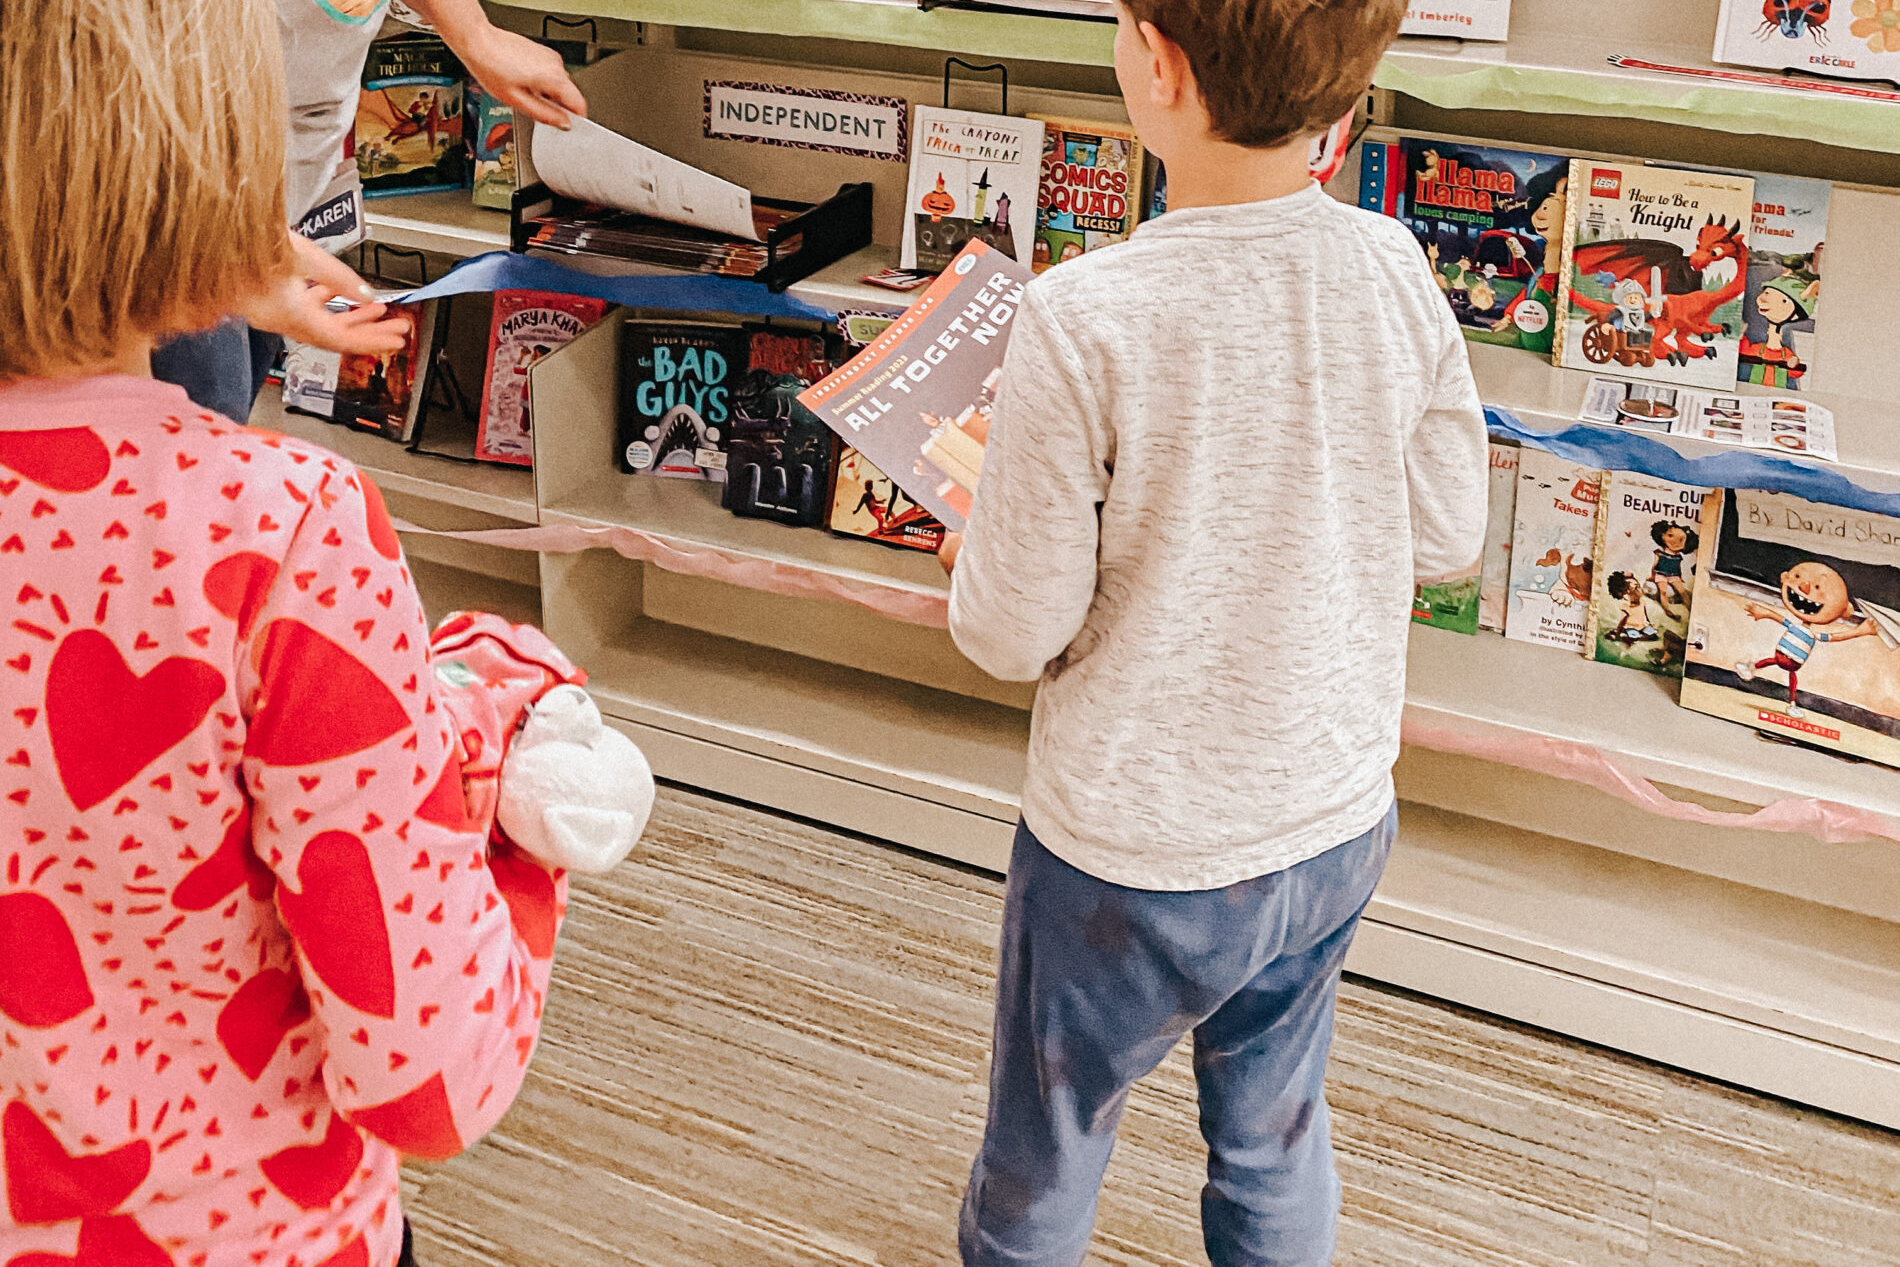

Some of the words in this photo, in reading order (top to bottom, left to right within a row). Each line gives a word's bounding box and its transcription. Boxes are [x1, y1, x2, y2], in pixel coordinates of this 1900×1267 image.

[1420, 11, 1472, 26] Emberley
[720, 100, 886, 139] INDEPENDENT
[978, 145, 1020, 161] TREAT
[1040, 158, 1128, 194] COMICS
[1436, 158, 1515, 194] llama
[1593, 177, 1618, 190] LEGO
[1037, 183, 1126, 219] SQUAD
[1415, 177, 1494, 213] llama
[1628, 188, 1655, 203] How
[1658, 194, 1670, 205] to
[1672, 192, 1689, 208] Be
[1690, 199, 1699, 209] a
[298, 197, 353, 236] KAREN
[1076, 216, 1121, 231] RECESS!
[1414, 204, 1443, 220] loves
[1446, 211, 1494, 228] camping
[1630, 203, 1693, 232] Knight
[1754, 225, 1795, 238] friends!
[502, 310, 547, 336] MARYA
[971, 281, 1025, 346] NOW
[1518, 315, 1543, 325] NETFLIX
[653, 346, 728, 385] BAD
[844, 396, 894, 432] ALL
[889, 271, 1013, 394] TOGETHER
[636, 379, 729, 423] GUYS
[832, 393, 863, 415] Summer
[860, 370, 893, 395] Reading
[1553, 498, 1588, 517] Takes
[1786, 508, 1846, 538] David
[1541, 617, 1551, 626] by
[1770, 714, 1839, 739] SCHOLASTIC
